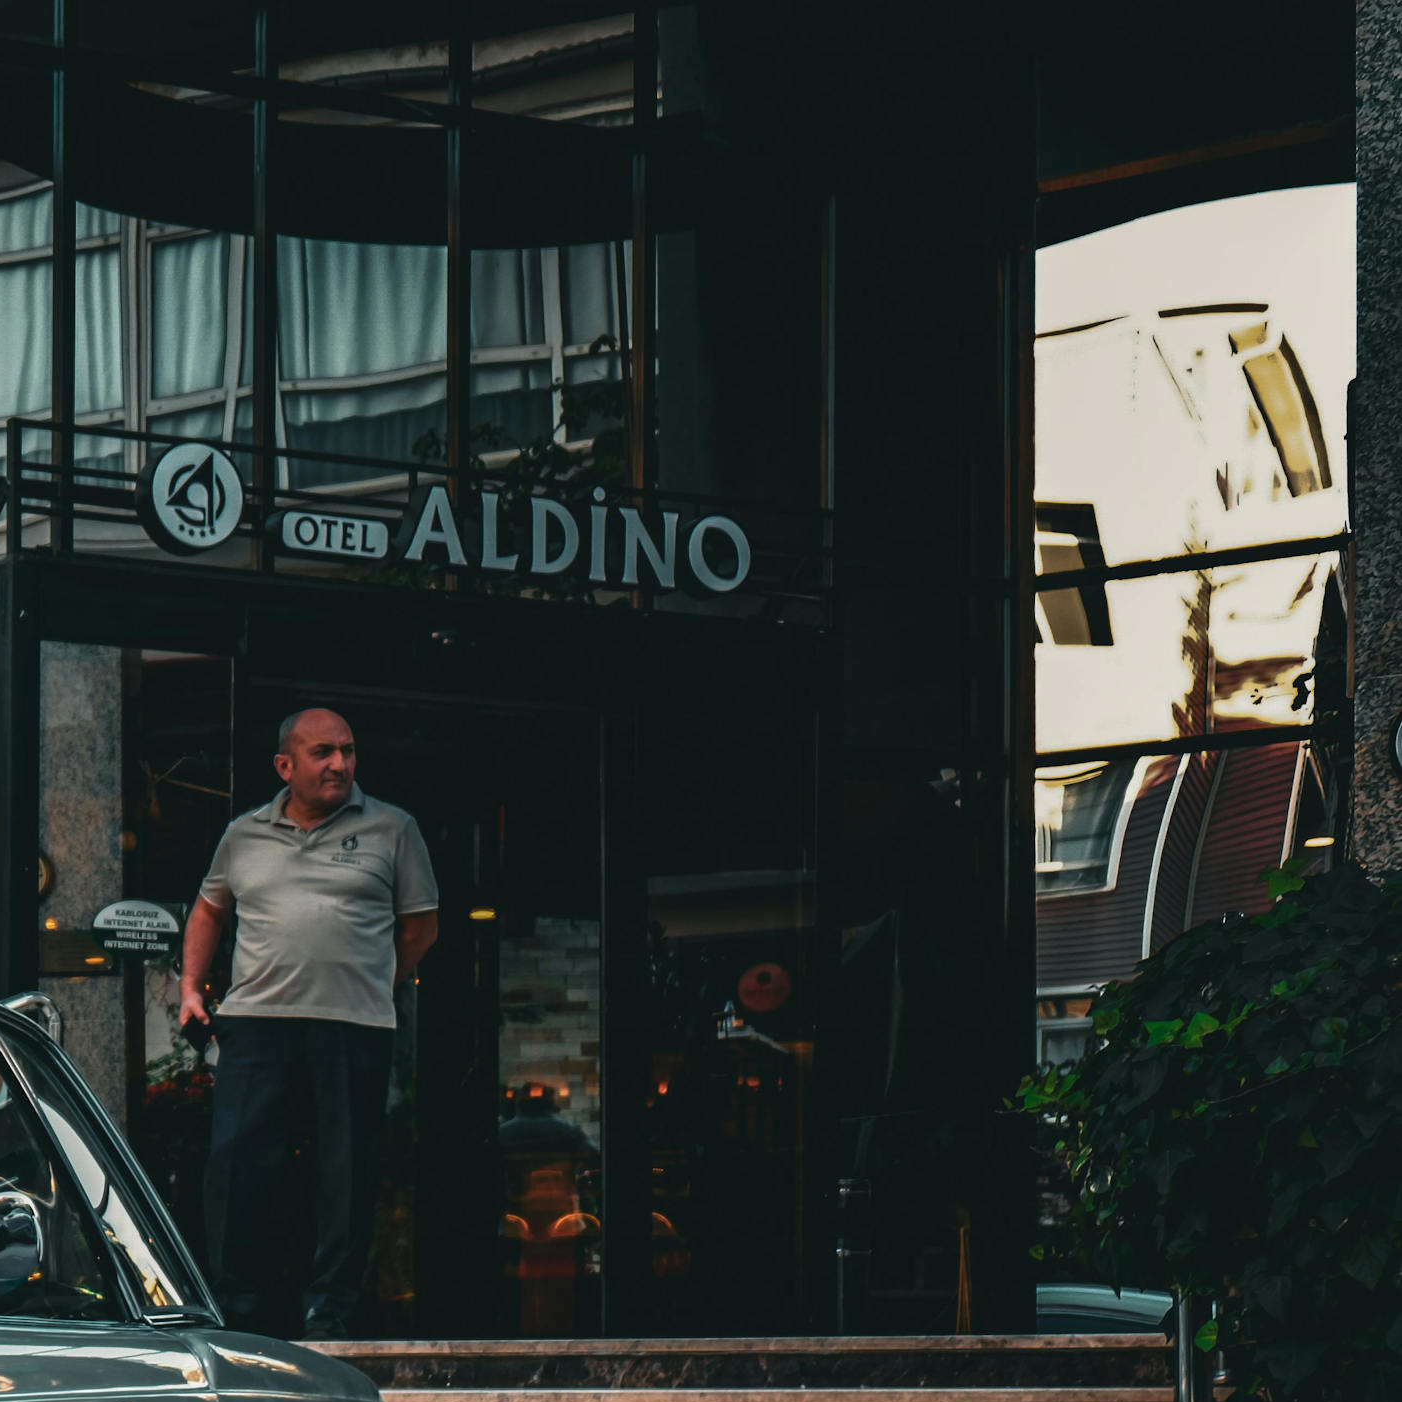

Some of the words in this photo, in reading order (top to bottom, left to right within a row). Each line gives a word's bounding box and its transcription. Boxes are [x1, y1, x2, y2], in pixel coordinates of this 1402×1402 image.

[294, 516, 376, 553] OTEL
[116, 910, 159, 918] KABLOSUZ
[116, 931, 158, 940] WIRELESS
[104, 940, 145, 949] INTERNET
[146, 943, 169, 951] ZONE
